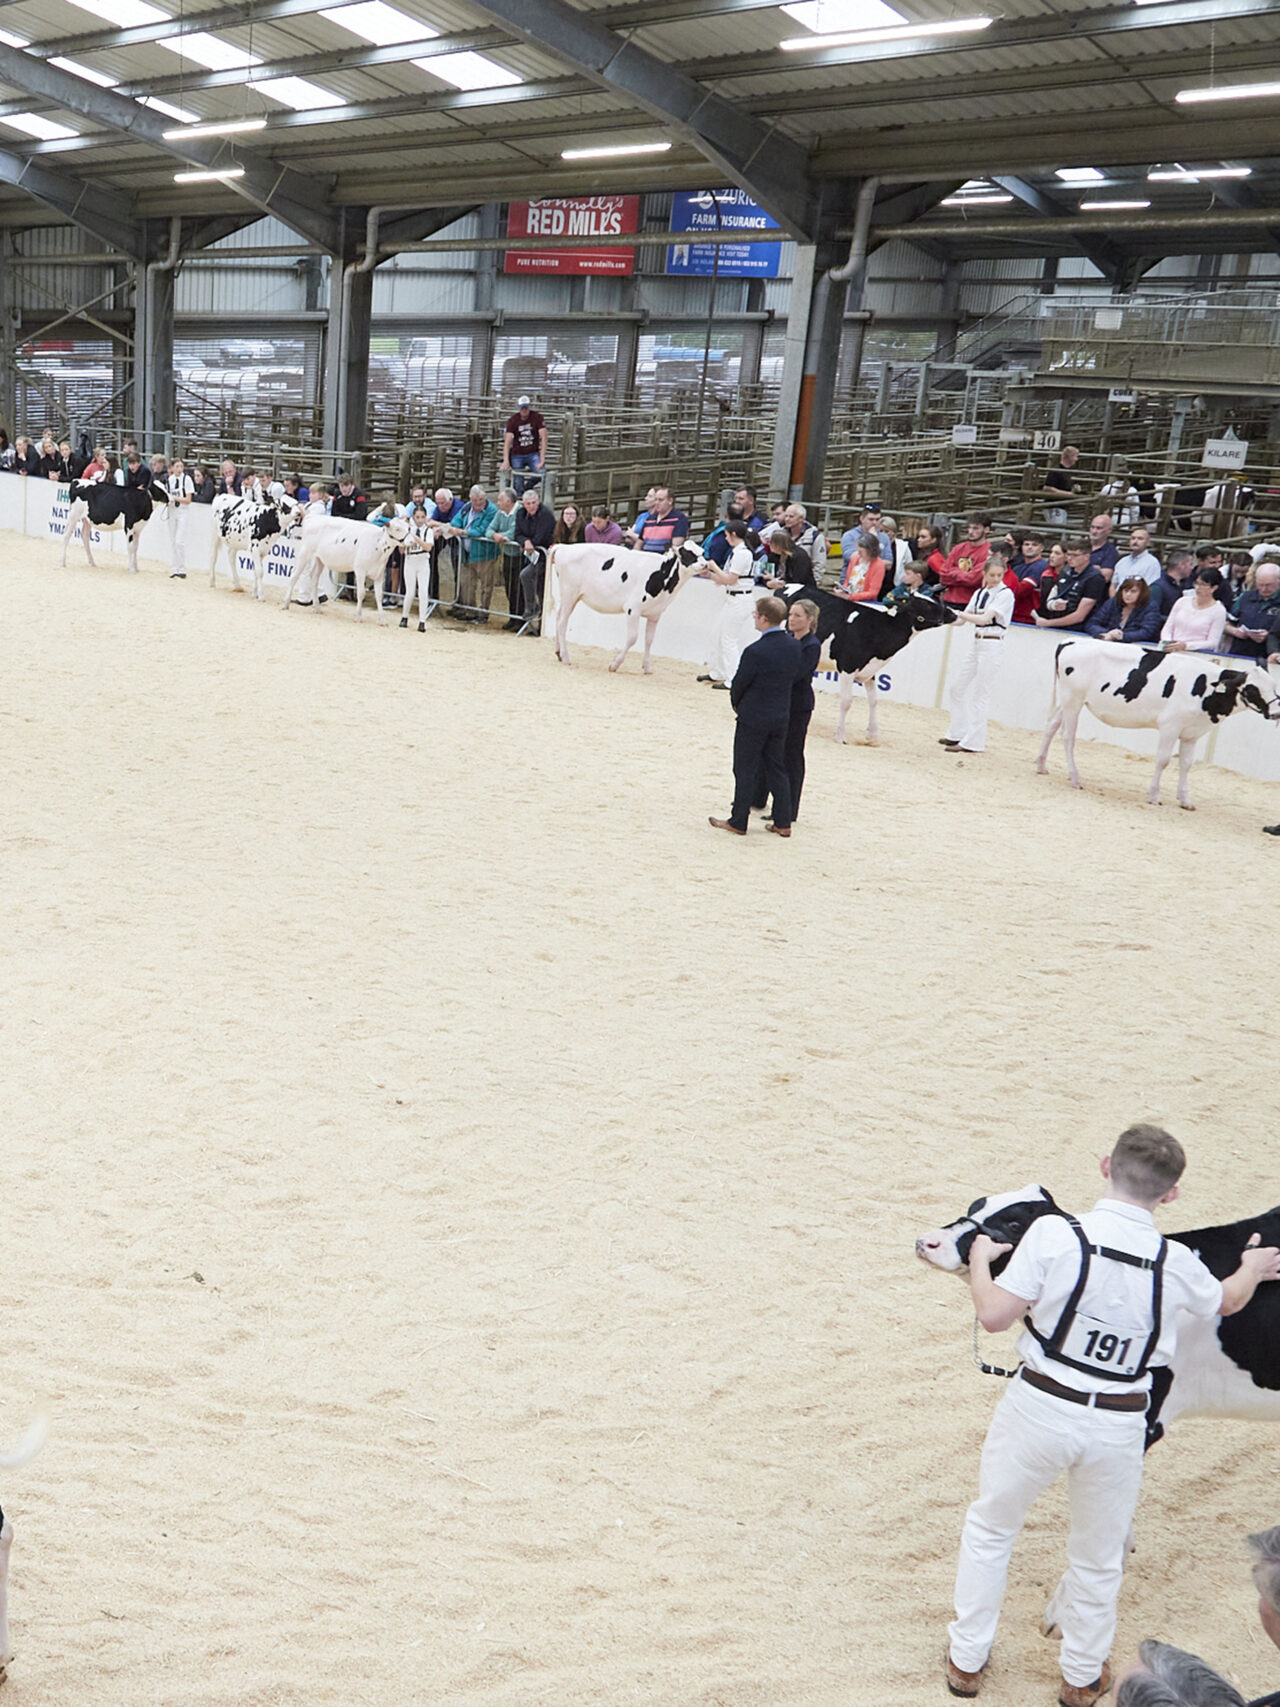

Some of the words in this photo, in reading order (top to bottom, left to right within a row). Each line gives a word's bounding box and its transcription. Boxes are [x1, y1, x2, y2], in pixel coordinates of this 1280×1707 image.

[720, 189, 757, 206] ZURIC
[526, 208, 565, 235] RED
[567, 210, 622, 236] MILLS
[691, 213, 717, 226] FARM
[721, 214, 767, 229] NSURANCE
[517, 258, 530, 267] PURE
[531, 259, 559, 268] NUTRITION
[239, 556, 255, 571] YM
[1084, 1330, 1132, 1365] 191
